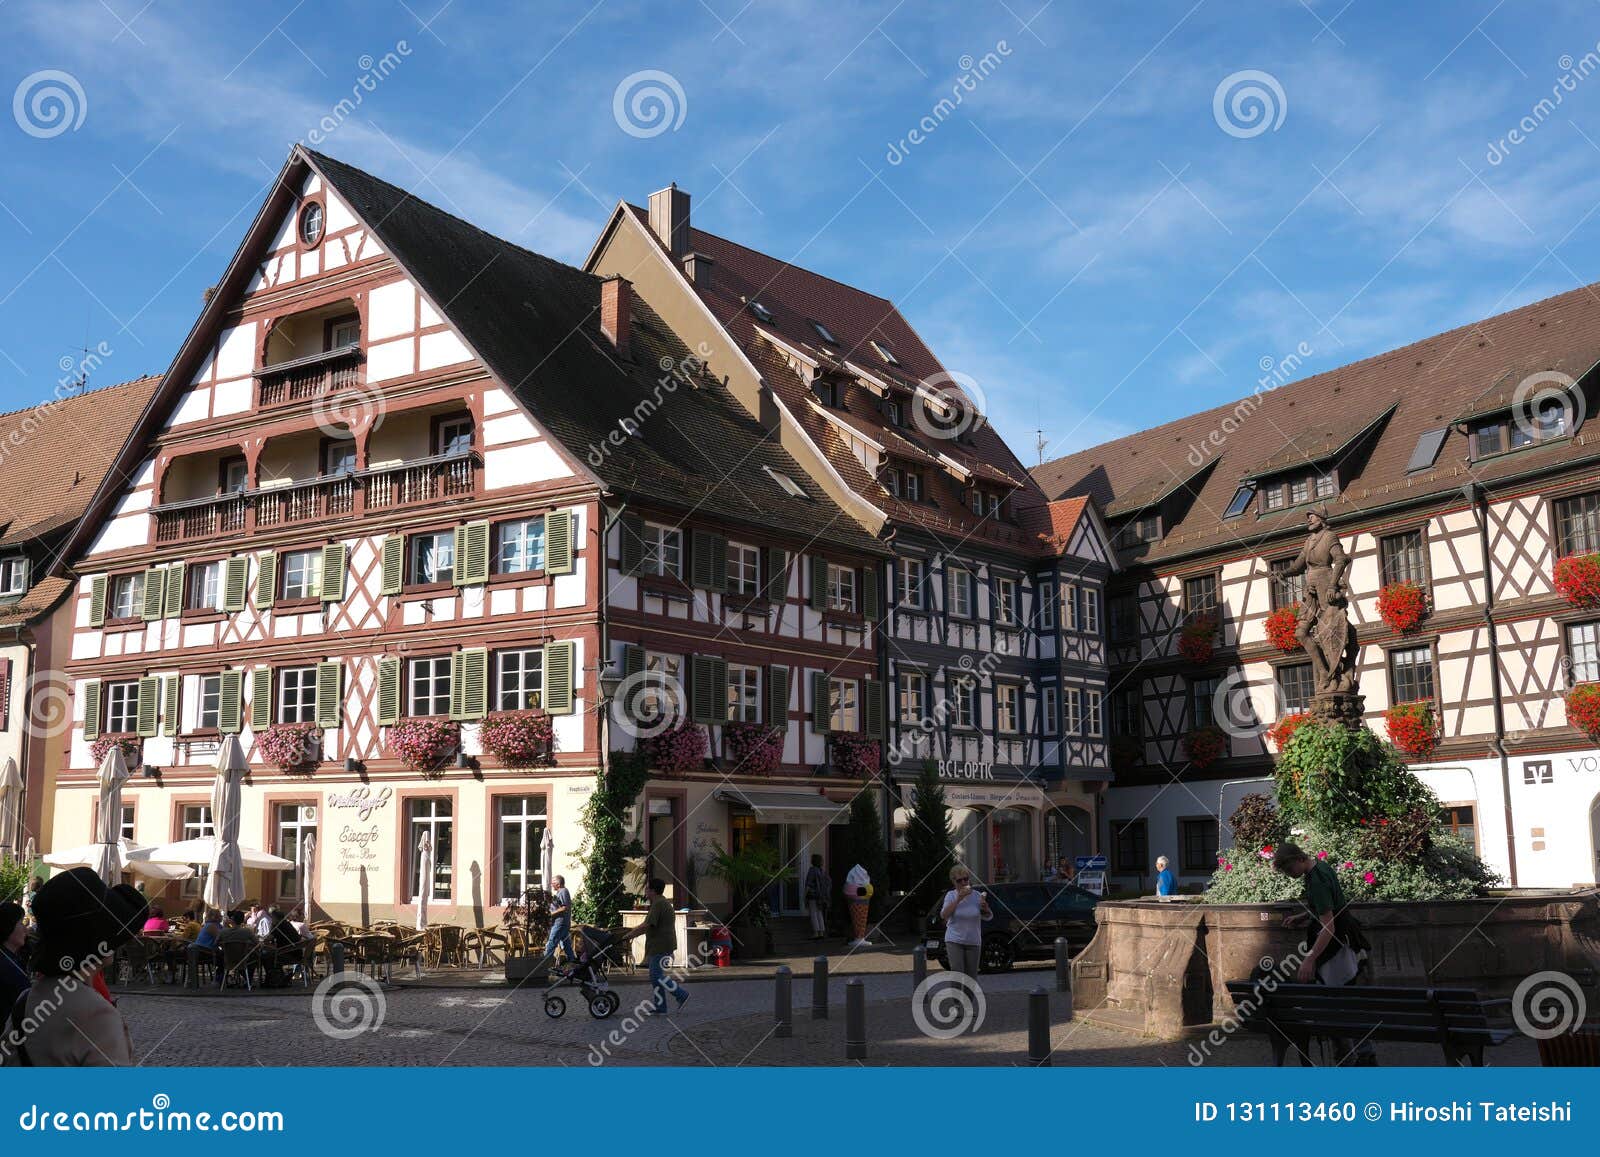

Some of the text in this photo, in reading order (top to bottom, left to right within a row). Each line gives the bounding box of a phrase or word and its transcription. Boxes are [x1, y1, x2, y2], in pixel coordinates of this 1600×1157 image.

[938, 760, 994, 780] BCL-OPTIC
[1566, 756, 1600, 773] VO
[339, 825, 379, 848] Eiscafé
